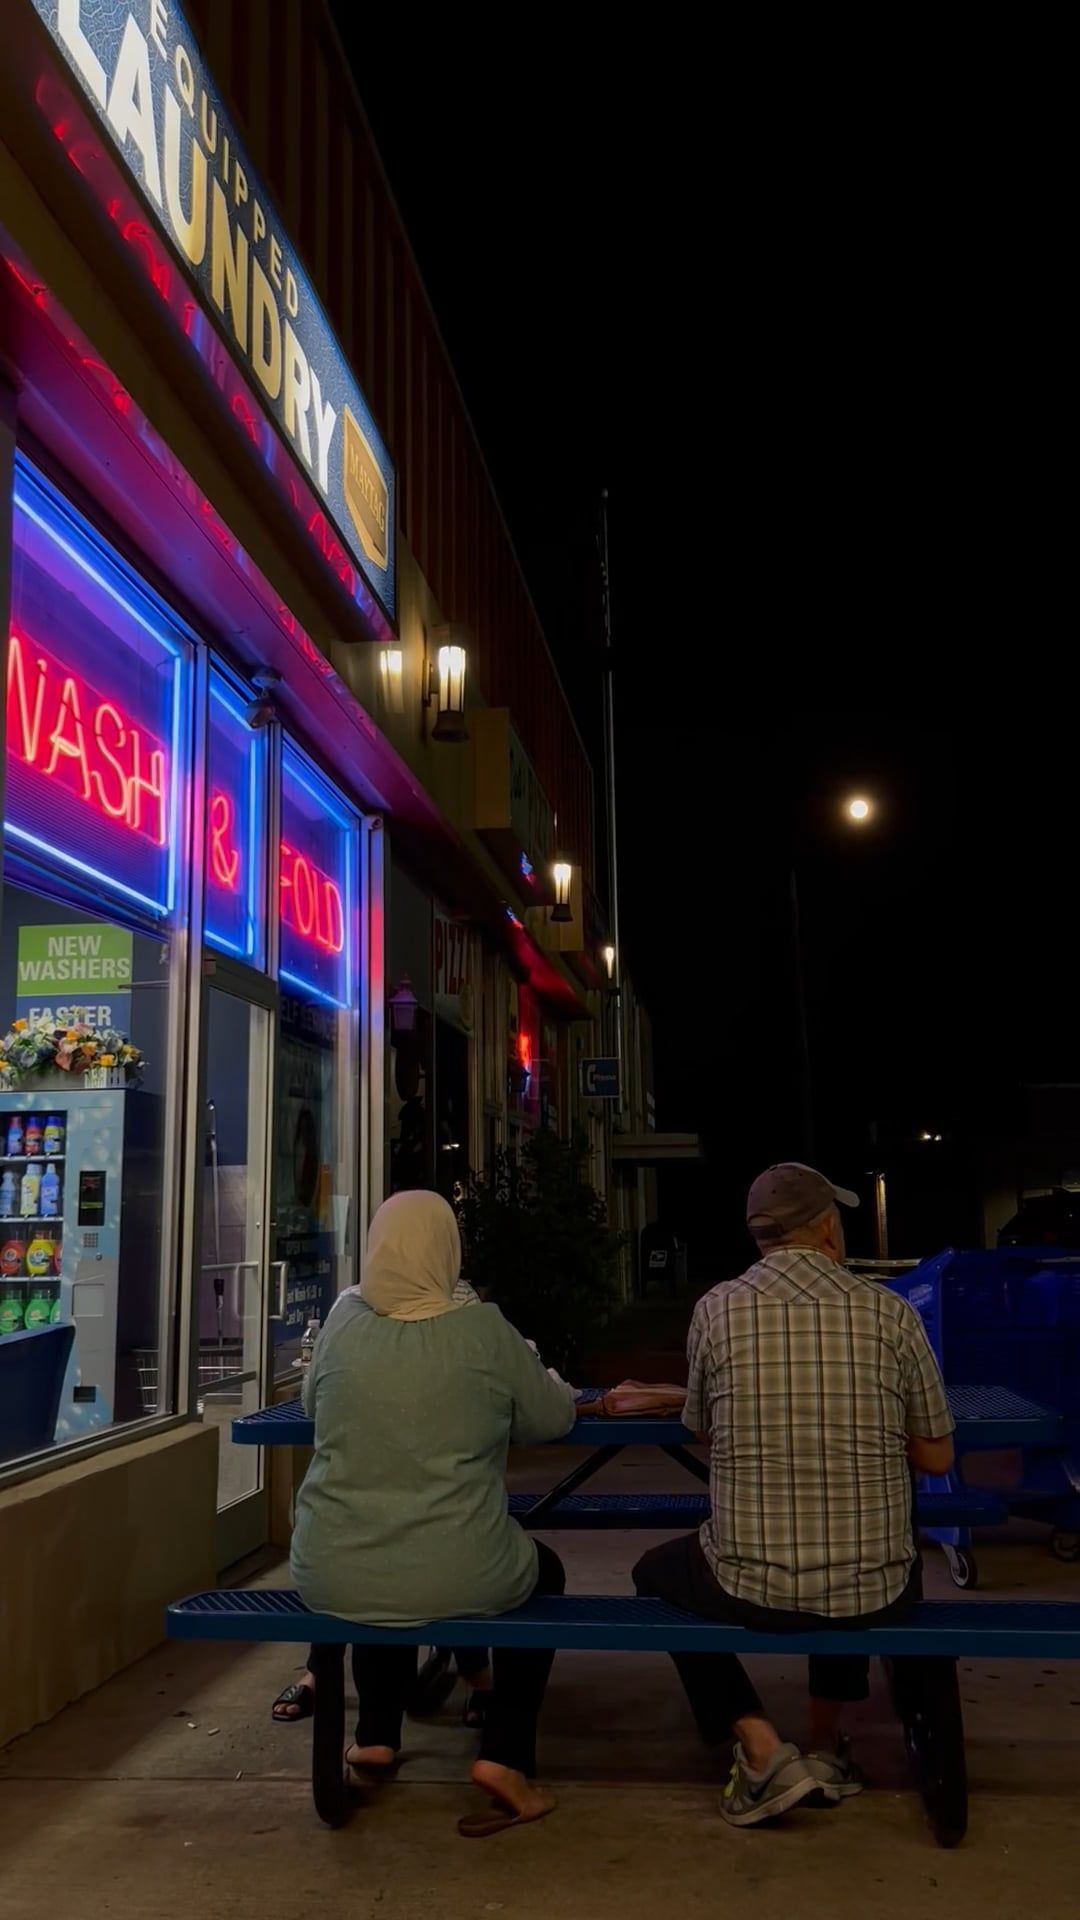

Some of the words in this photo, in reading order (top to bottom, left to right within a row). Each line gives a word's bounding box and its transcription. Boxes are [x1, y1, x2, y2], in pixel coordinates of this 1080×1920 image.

[151, 0, 299, 318] EQUIPPED
[58, 0, 336, 495] LAUNDRY
[211, 795, 239, 888] &
[19, 957, 131, 982] WASHERS
[48, 935, 102, 957] NEW
